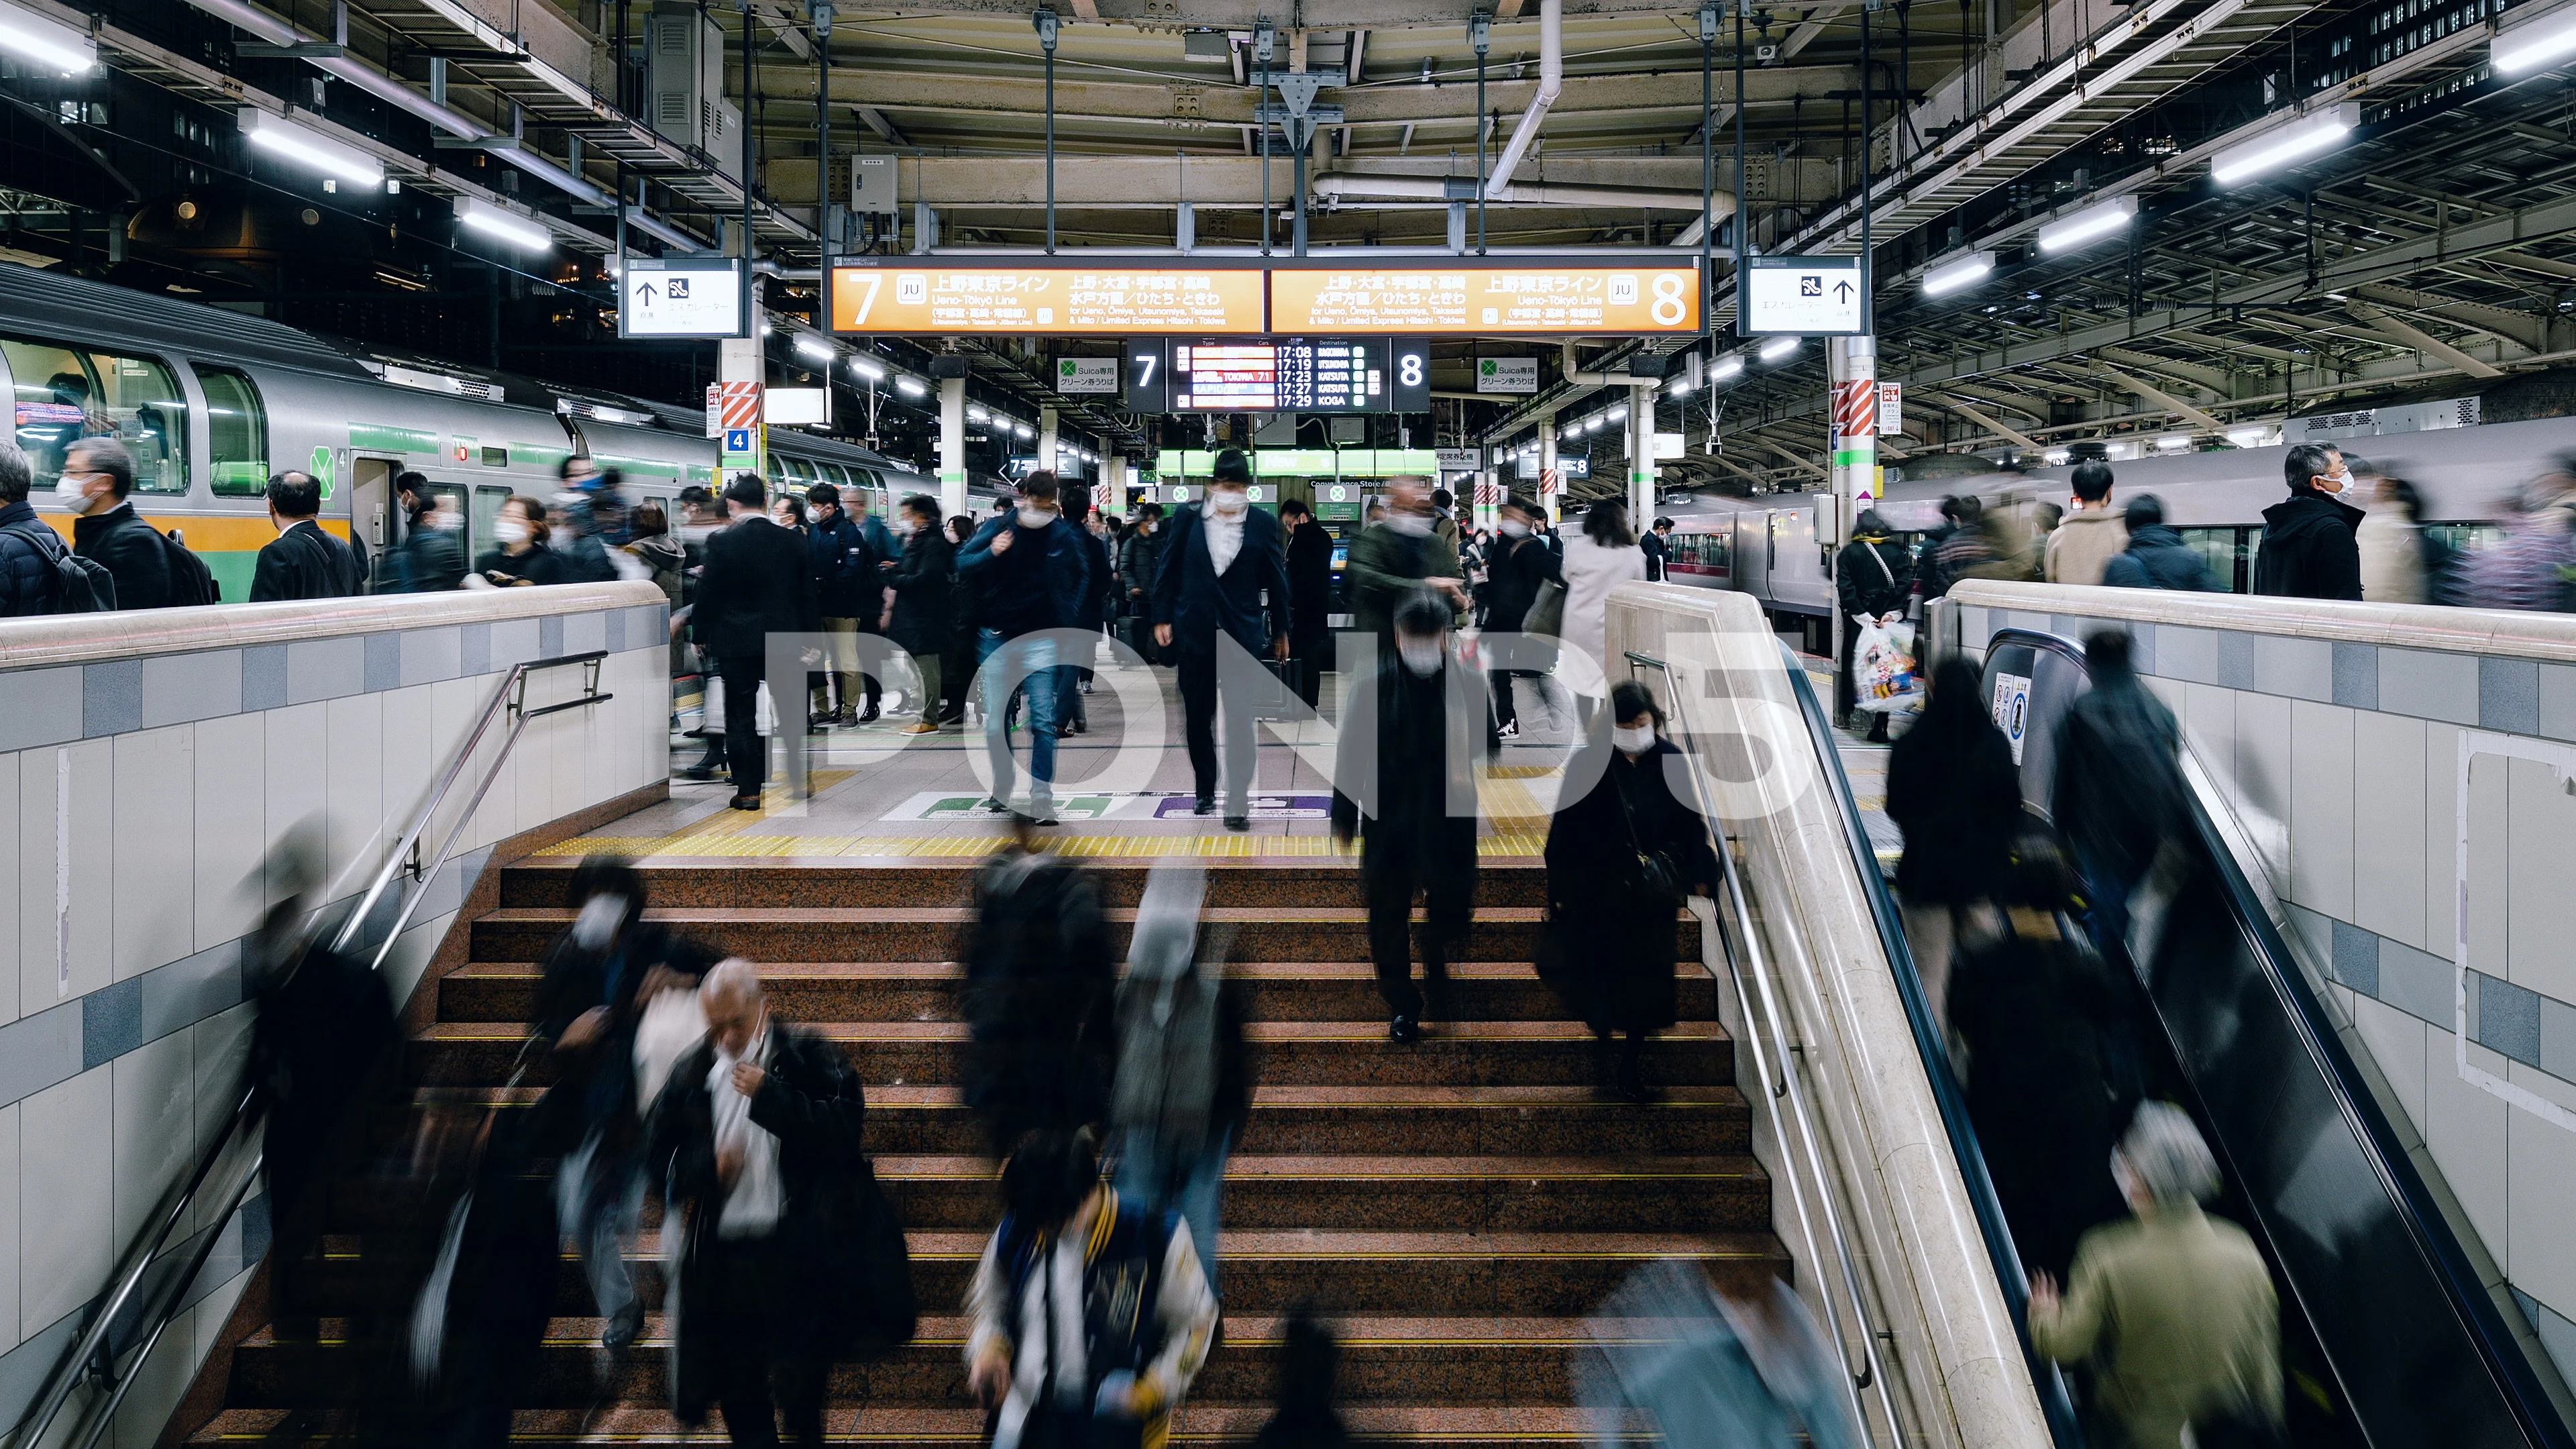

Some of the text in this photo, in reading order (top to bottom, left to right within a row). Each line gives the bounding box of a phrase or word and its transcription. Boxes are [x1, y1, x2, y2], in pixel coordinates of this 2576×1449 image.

[904, 284, 919, 295] JU
[932, 274, 1051, 293] 上野東京ライン
[1484, 275, 1603, 293] 上野東京ライン
[1615, 284, 1630, 295] JU
[849, 273, 882, 325] 7
[995, 295, 1018, 305] Line
[1580, 295, 1603, 305] Line
[1650, 273, 1687, 326] 8
[1069, 307, 1081, 315] for
[1082, 307, 1106, 316] Ueno,
[1189, 307, 1224, 315] Takasaki
[1324, 307, 1348, 316] Ueno,
[1431, 307, 1466, 315] Takasaki
[1069, 317, 1075, 325] &
[1077, 317, 1095, 325] Mito
[1101, 317, 1130, 325] Limited
[1132, 317, 1165, 326] Express
[1309, 317, 1316, 325] &
[1318, 317, 1335, 325] Mito
[1342, 317, 1370, 325] Limited
[1372, 317, 1404, 327] Express
[1277, 346, 1312, 358] 17:08
[1277, 358, 1312, 370] 17:19
[1399, 354, 1423, 386] 8
[1078, 368, 1114, 376] Suica専用
[1135, 355, 1157, 387] 7
[1223, 372, 1255, 382] TOKIWA
[1257, 372, 1269, 382] 71
[1277, 370, 1312, 382] 17:23
[1318, 372, 1350, 382] KATSUTA
[1499, 367, 1535, 375] Suica専用
[1061, 378, 1115, 386] グリーン券うりば
[1481, 377, 1535, 386] グリーン券うりば
[1277, 382, 1312, 394] 17:27
[1318, 384, 1350, 394] KATSUTA
[1277, 394, 1346, 407] 17:29 KOGA
[733, 433, 744, 448] 4
[339, 451, 345, 468] 4
[1010, 460, 1020, 473] 7
[1577, 460, 1587, 474] 8
